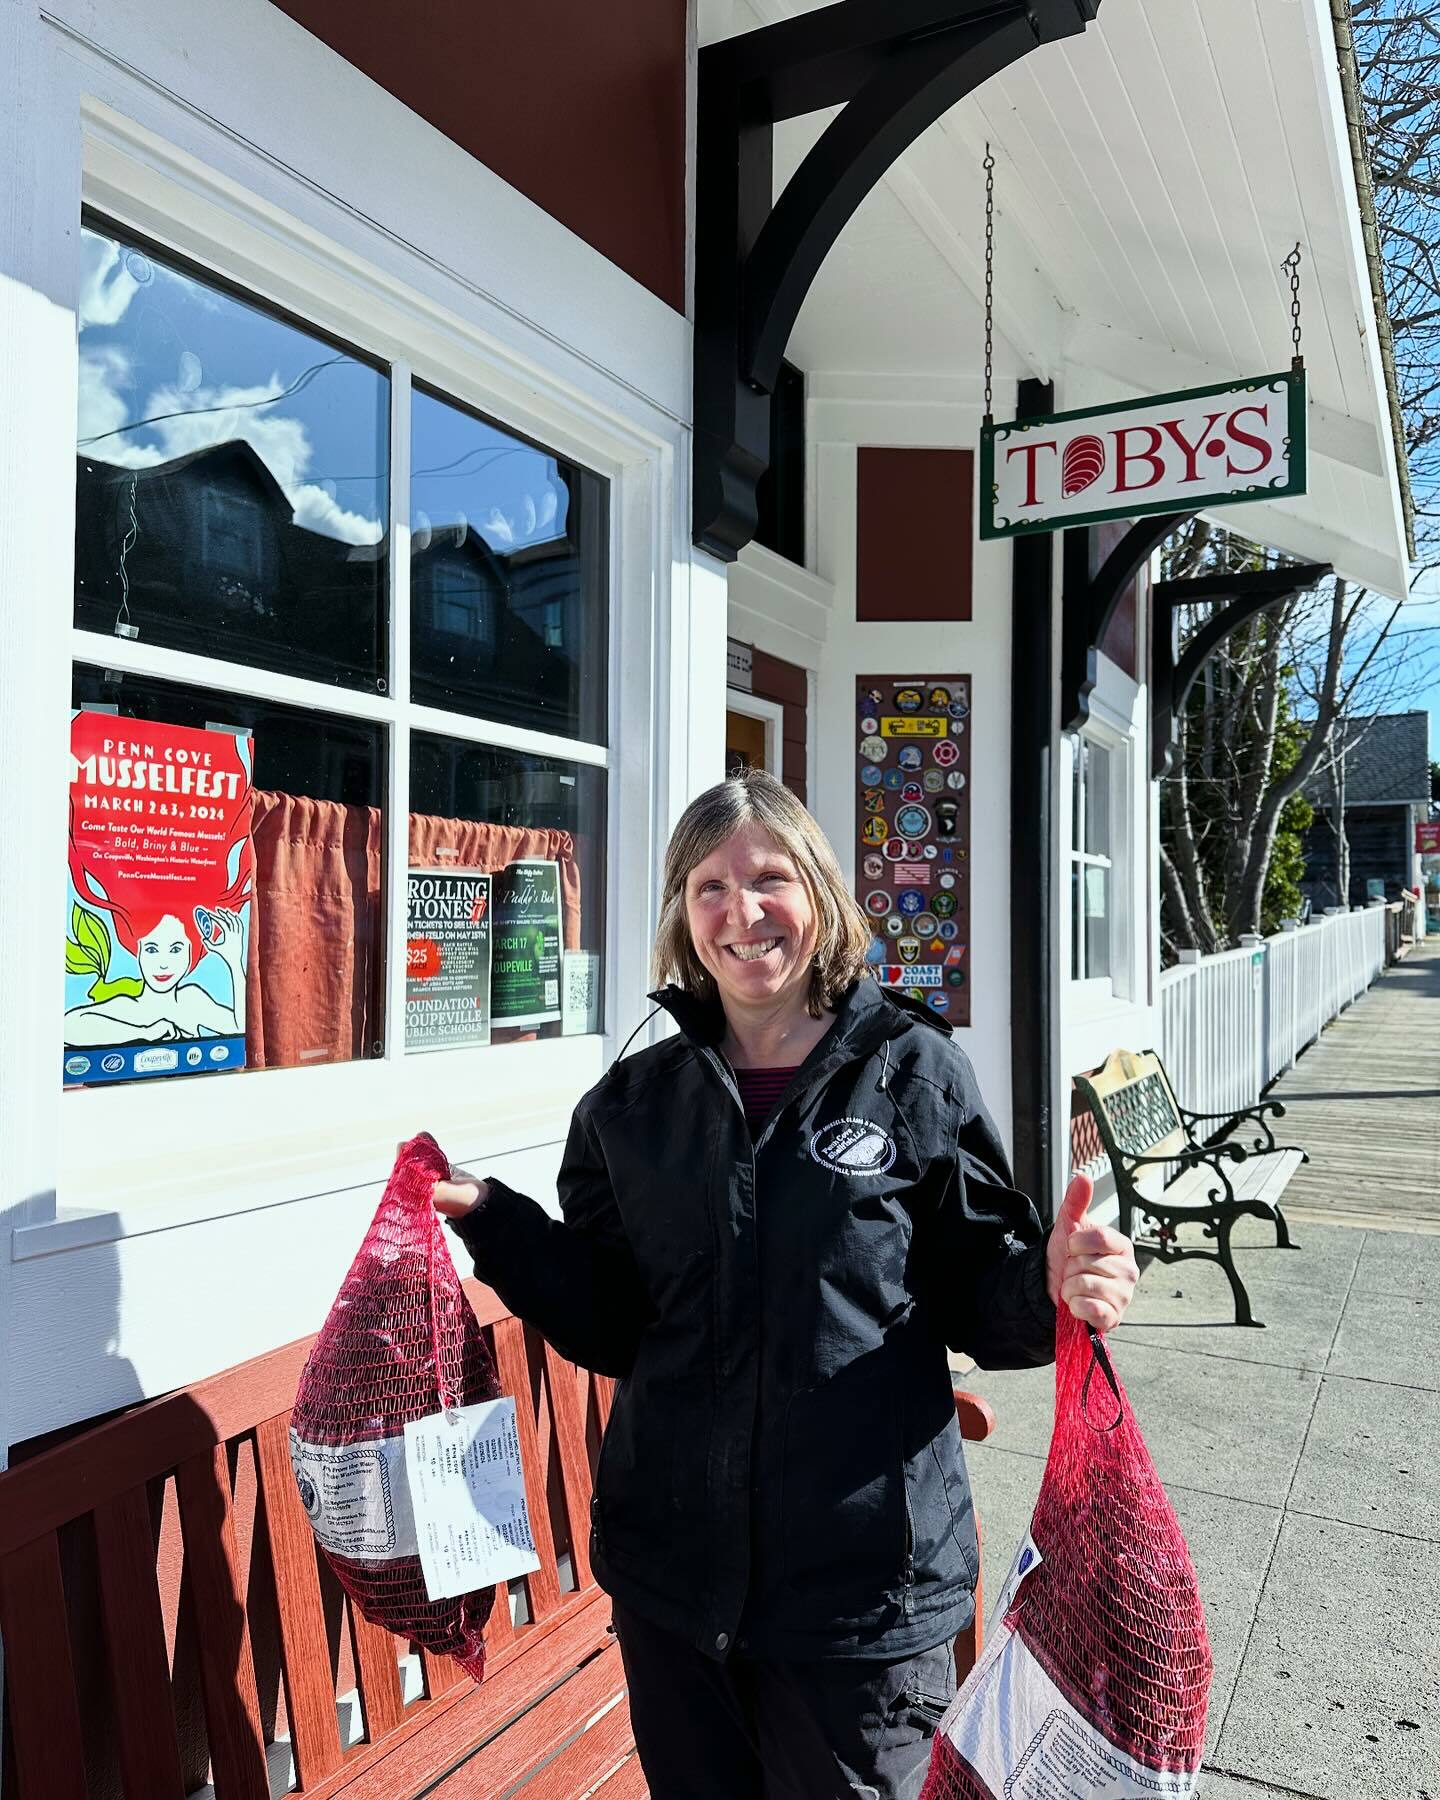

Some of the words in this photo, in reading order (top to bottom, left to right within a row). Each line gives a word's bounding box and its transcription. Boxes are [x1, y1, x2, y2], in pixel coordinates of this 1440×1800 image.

[103, 739, 154, 759] PENN
[164, 747, 212, 767] COVE
[69, 754, 241, 800] MUSSELFEST
[84, 793, 143, 813] MARCH
[189, 805, 225, 821] 2024
[81, 820, 106, 831] Come
[108, 822, 129, 833] Taste
[130, 824, 145, 834] Our
[146, 825, 168, 837] World
[168, 828, 196, 839] Famous
[197, 830, 226, 841] Mussels!
[114, 836, 139, 850] Bold,
[142, 838, 167, 854] Briny
[170, 841, 177, 851] &
[180, 842, 200, 853] Blue
[92, 851, 102, 860] On
[135, 854, 169, 864] Washington's
[169, 856, 190, 864] Historic
[118, 870, 197, 882] PennCoveMusselfest.com
[407, 879, 488, 901] ROLLING
[502, 884, 539, 914] Paddy's
[414, 920, 443, 929] TICKETS
[443, 920, 453, 929] TO
[453, 920, 465, 929] SEE
[480, 920, 489, 929] AT
[425, 931, 444, 940] FIELD
[445, 931, 456, 940] ON
[456, 931, 471, 940] MAY
[495, 937, 518, 951] ARCH
[520, 937, 528, 949] 17
[406, 947, 428, 966] $25
[493, 960, 533, 973] OUPEVILLE
[904, 966, 941, 976] COAST
[903, 975, 941, 986] GUARD
[406, 997, 477, 1013] OUNDATION
[405, 1026, 436, 1038] UBLIC
[438, 1022, 482, 1036] SCHOOLS
[821, 1139, 840, 1154] Penn
[836, 1128, 853, 1142] Cove
[340, 1469, 371, 1478] Warehouse
[1054, 1737, 1071, 1756] Oysters
[1070, 1755, 1085, 1768] From
[1084, 1767, 1093, 1776] the
[1060, 1727, 1086, 1754] Sustainably
[1099, 1766, 1117, 1782] Raised
[1076, 1751, 1091, 1767] Clams
[1091, 1766, 1101, 1777] and
[1040, 1757, 1070, 1791] International
[1059, 1772, 1067, 1780] of
[1080, 1771, 1097, 1788] Pacific
